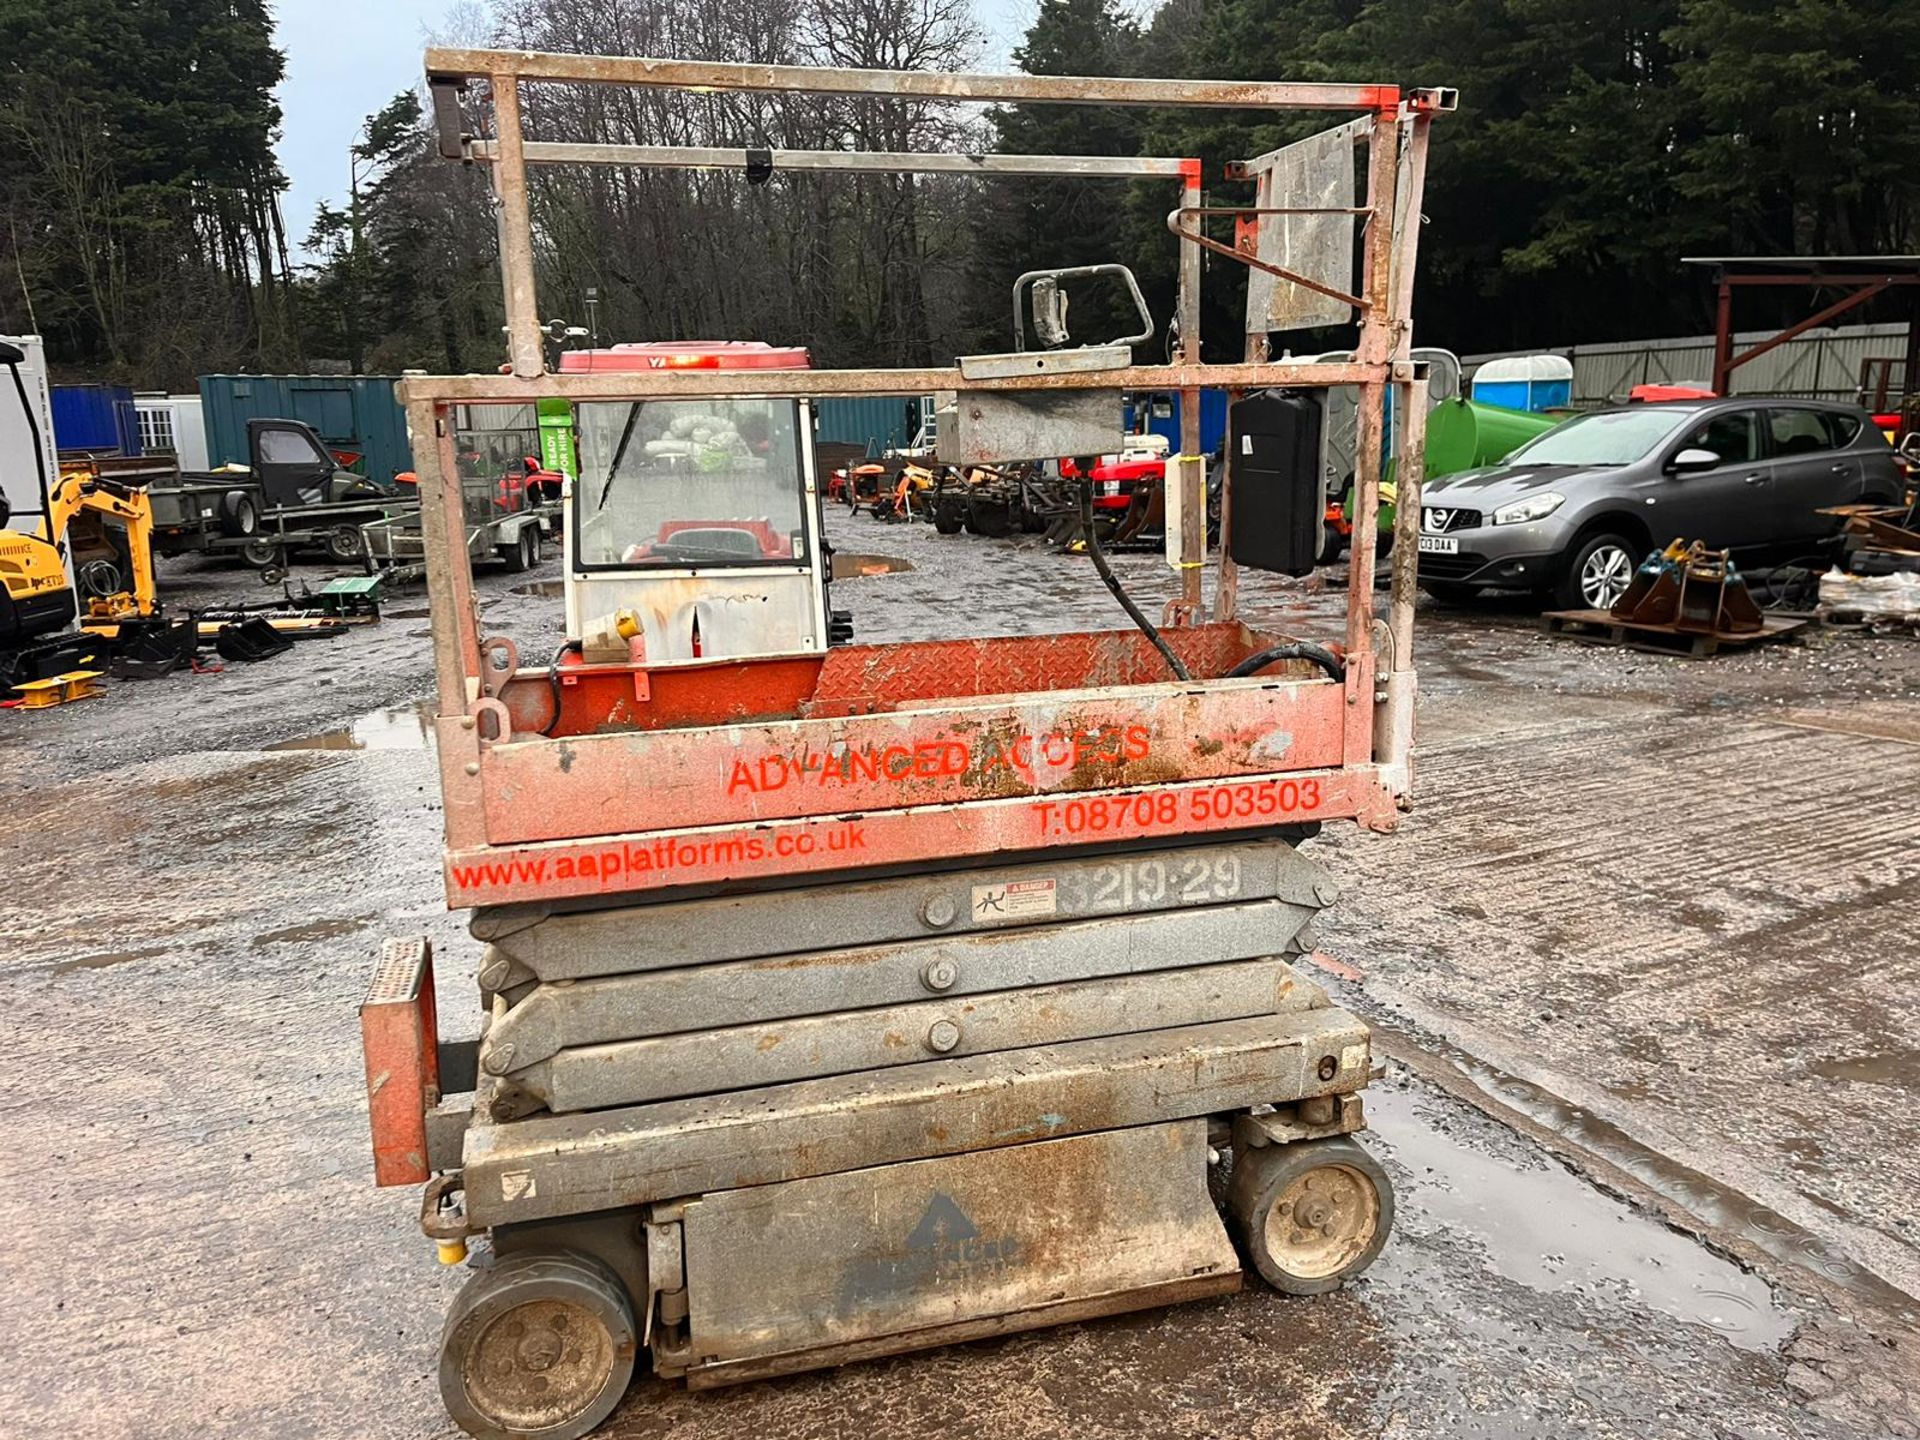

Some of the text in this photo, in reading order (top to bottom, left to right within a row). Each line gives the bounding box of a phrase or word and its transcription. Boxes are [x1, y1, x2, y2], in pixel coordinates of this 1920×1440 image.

[728, 741, 969, 795] ADVANCED
[1032, 779, 1321, 836] T:08708 503503
[451, 823, 866, 890] www.aaplatforms.co.uk
